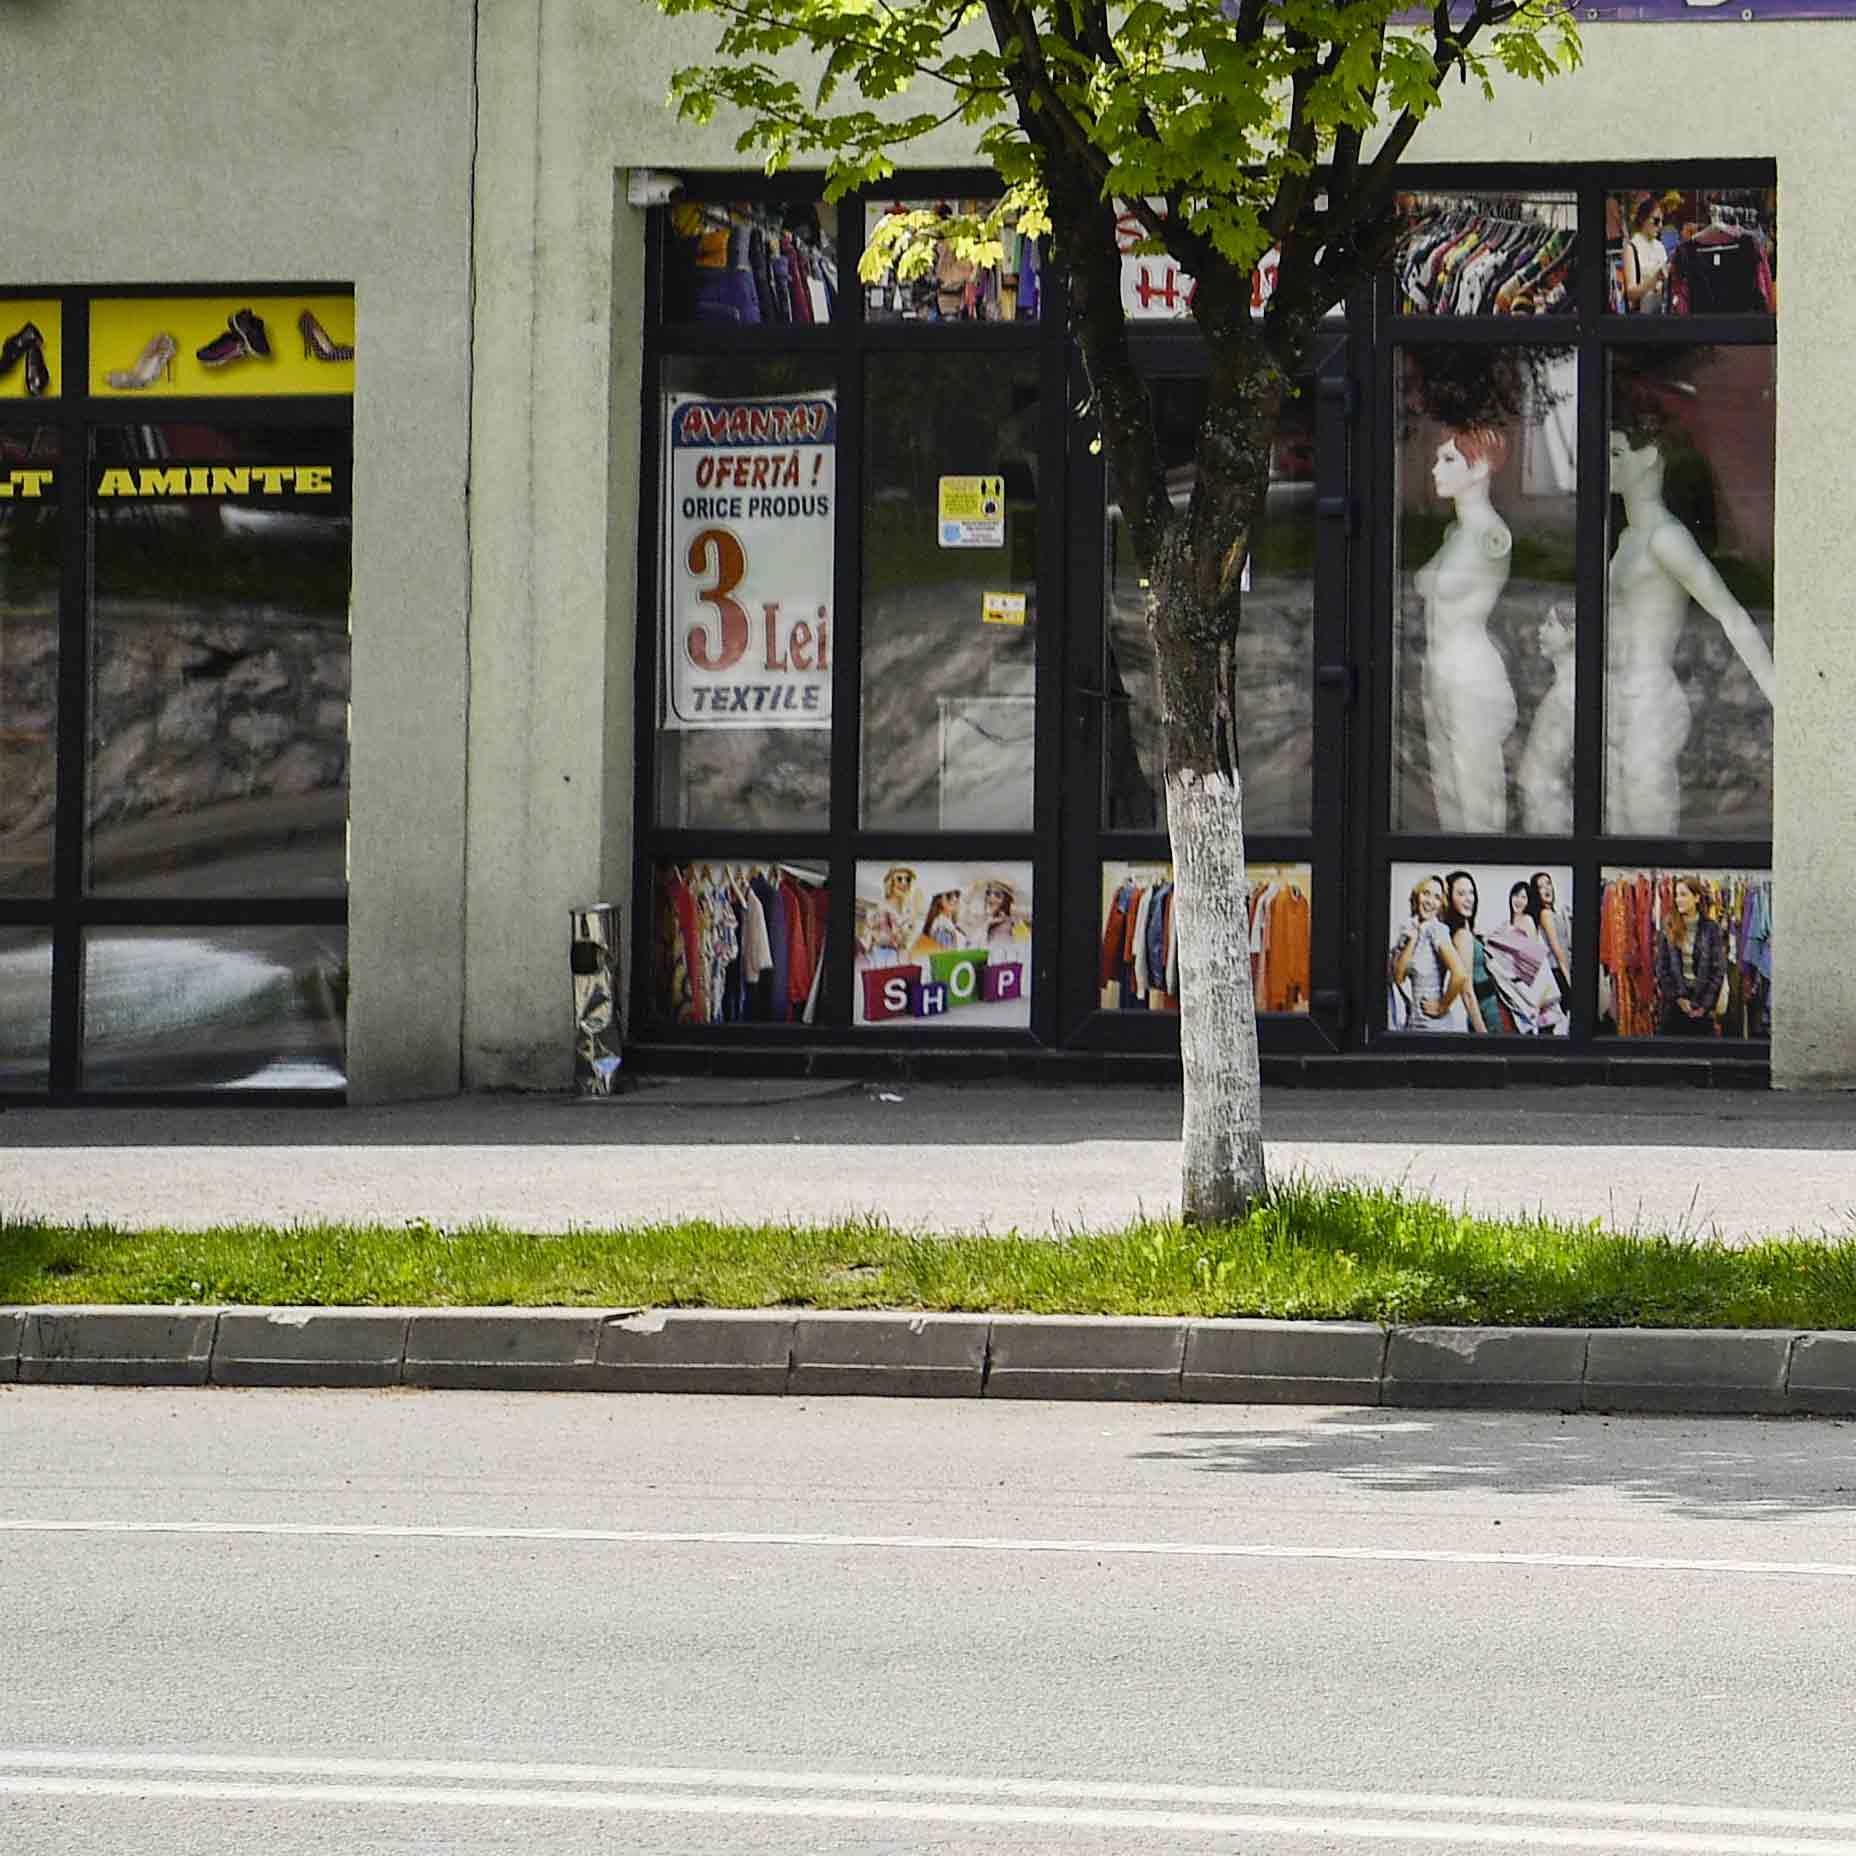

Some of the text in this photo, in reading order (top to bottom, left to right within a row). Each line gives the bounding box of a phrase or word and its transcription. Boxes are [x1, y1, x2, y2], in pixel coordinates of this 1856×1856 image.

[681, 403, 828, 443] AVANTAJ
[98, 466, 332, 496] AMINTE
[682, 495, 829, 519] ORICE PRODUS
[685, 528, 828, 673] 3 Lei
[692, 686, 820, 711] TEXTILE
[883, 961, 1015, 1015] SHOP
